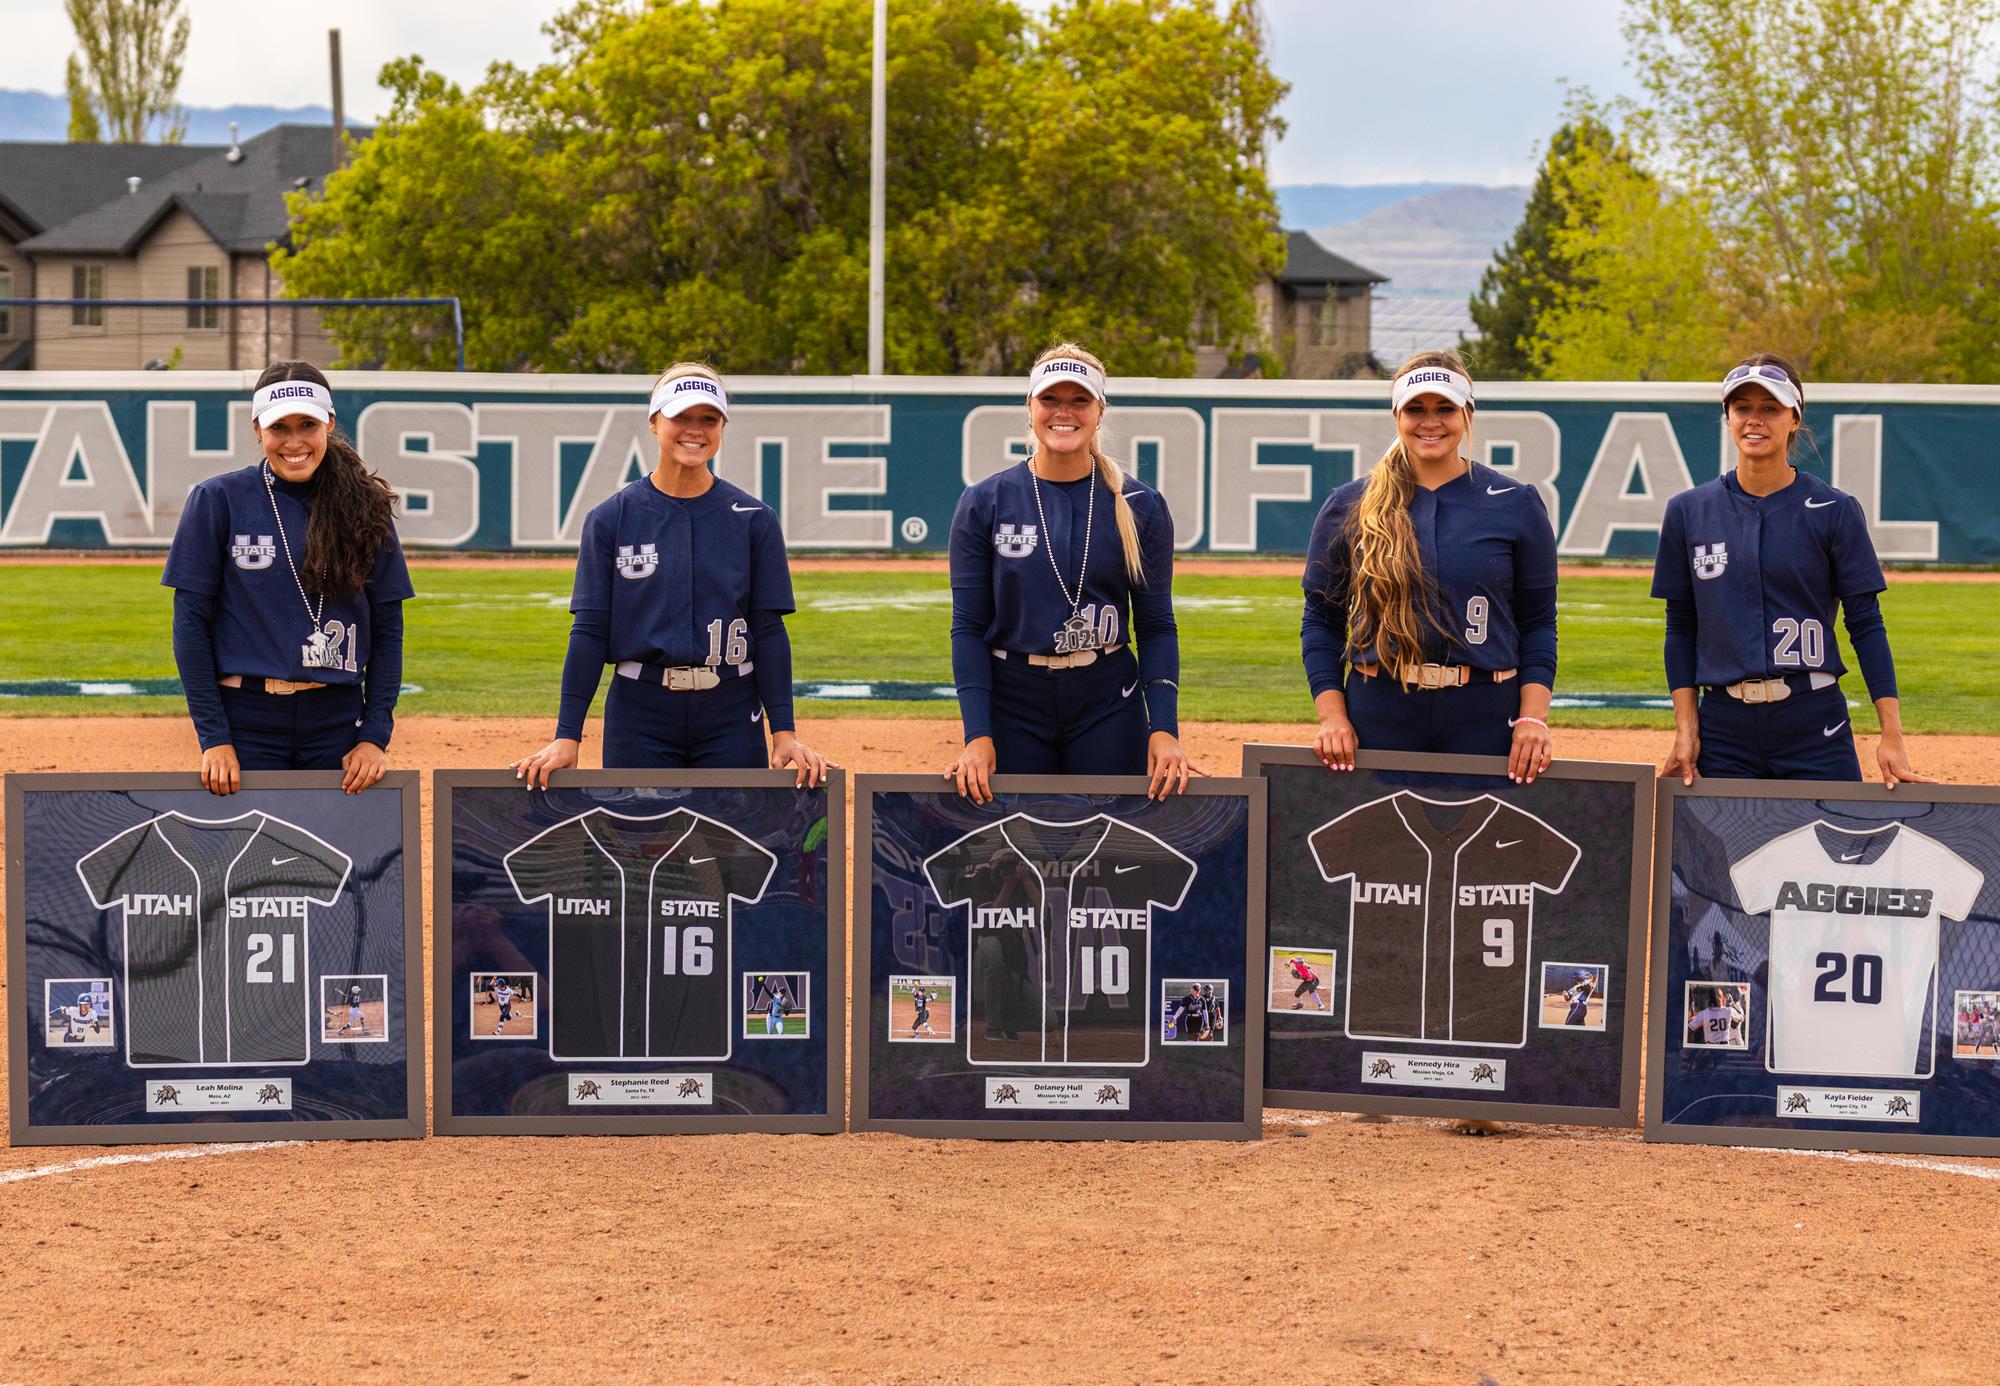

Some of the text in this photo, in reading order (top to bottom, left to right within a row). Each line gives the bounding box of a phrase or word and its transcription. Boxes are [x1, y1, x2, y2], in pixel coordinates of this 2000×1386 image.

[1043, 362, 1087, 376] AGGIES
[674, 381, 717, 395] AGGIES
[1407, 372, 1451, 387] AGGIES
[269, 387, 314, 402] AGGIES
[994, 533, 1038, 547] STATE
[231, 545, 276, 558] STATE
[615, 552, 659, 569] STATE
[1693, 552, 1728, 570] STATE
[1080, 603, 1119, 646] 10
[1465, 596, 1488, 645] 9
[704, 617, 748, 666] 16
[1053, 627, 1102, 654] 2021
[1772, 617, 1825, 668] 20
[1355, 881, 1531, 906] UTAH STATE
[1775, 881, 1933, 918] AGGIES
[123, 894, 305, 918] UTAH STATE
[557, 898, 720, 918] UTAH STATE
[1069, 907, 1147, 930] STATE
[663, 926, 714, 976] 16
[1482, 918, 1515, 968] 9
[246, 933, 296, 984] 21
[1081, 945, 1130, 996] 10
[1813, 952, 1884, 1005] 20
[1710, 1017, 1727, 1032] 20
[1408, 1059, 1460, 1069] Kennedy Hira
[196, 1084, 243, 1092] Leah Molina
[611, 1079, 649, 1087] Stephanie
[1034, 1083, 1083, 1092] Delaney Hull
[1824, 1093, 1874, 1102] Kayla Fielder
